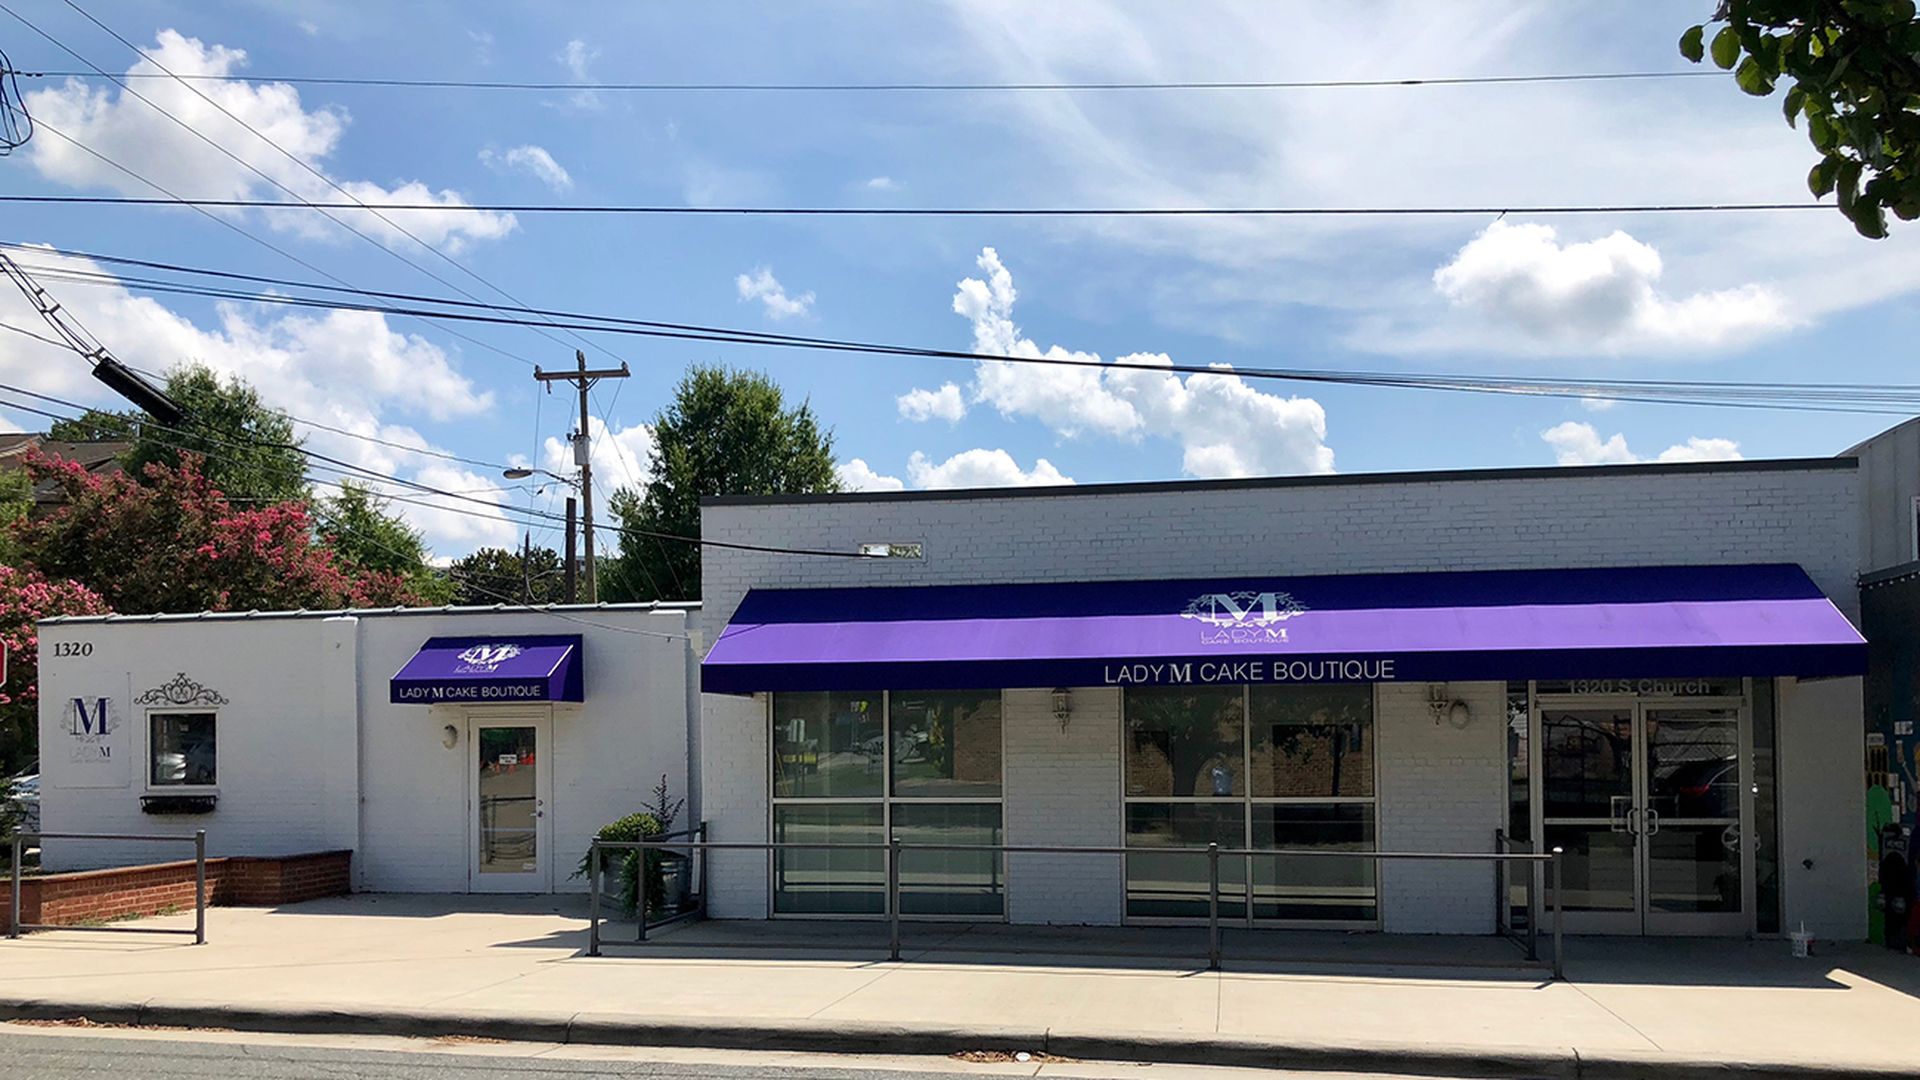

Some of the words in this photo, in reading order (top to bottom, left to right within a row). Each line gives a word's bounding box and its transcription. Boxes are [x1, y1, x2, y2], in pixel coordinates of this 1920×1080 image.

[1200, 629, 1261, 640] LADY
[1265, 628, 1288, 639] M
[1233, 636, 1290, 644] BOUTIQUE
[53, 642, 93, 657] 1320
[1104, 664, 1164, 683] LADY
[1169, 663, 1193, 683] M
[1200, 662, 1264, 681] CAKE
[1273, 659, 1396, 680] BOUTIQUE
[400, 687, 430, 698] LADY
[432, 687, 445, 698] M
[446, 687, 478, 697] CAKE
[481, 685, 541, 697] BOUTIQUE
[1567, 680, 1612, 694] 1320
[1618, 679, 1632, 694] S
[1638, 678, 1710, 695] Church
[69, 697, 111, 735] M
